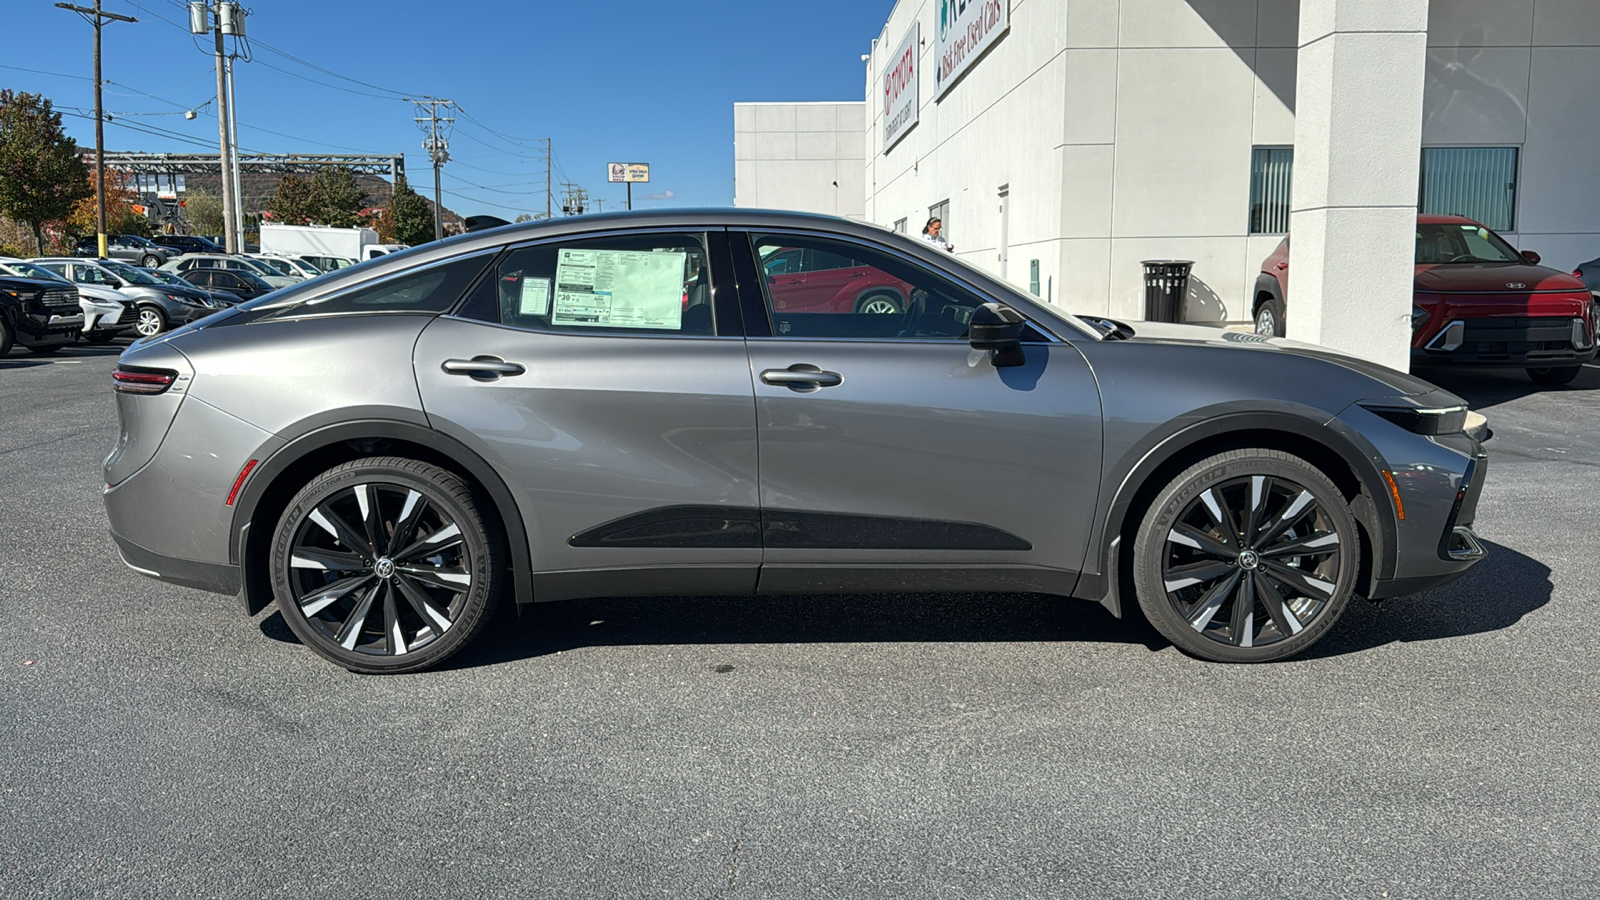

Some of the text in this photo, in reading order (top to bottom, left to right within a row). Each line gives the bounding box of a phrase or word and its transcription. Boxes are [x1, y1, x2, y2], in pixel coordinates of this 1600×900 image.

[942, 44, 953, 81] Risk
[954, 35, 966, 69] Free
[967, 5, 983, 53] Used
[985, 0, 1000, 34] Cars
[892, 44, 913, 103] TOYOTA
[326, 477, 342, 487] TOUR
[1169, 469, 1223, 512] MICHELIN
[276, 508, 301, 570] MICHELIN
[459, 571, 486, 632] MICHELIN
